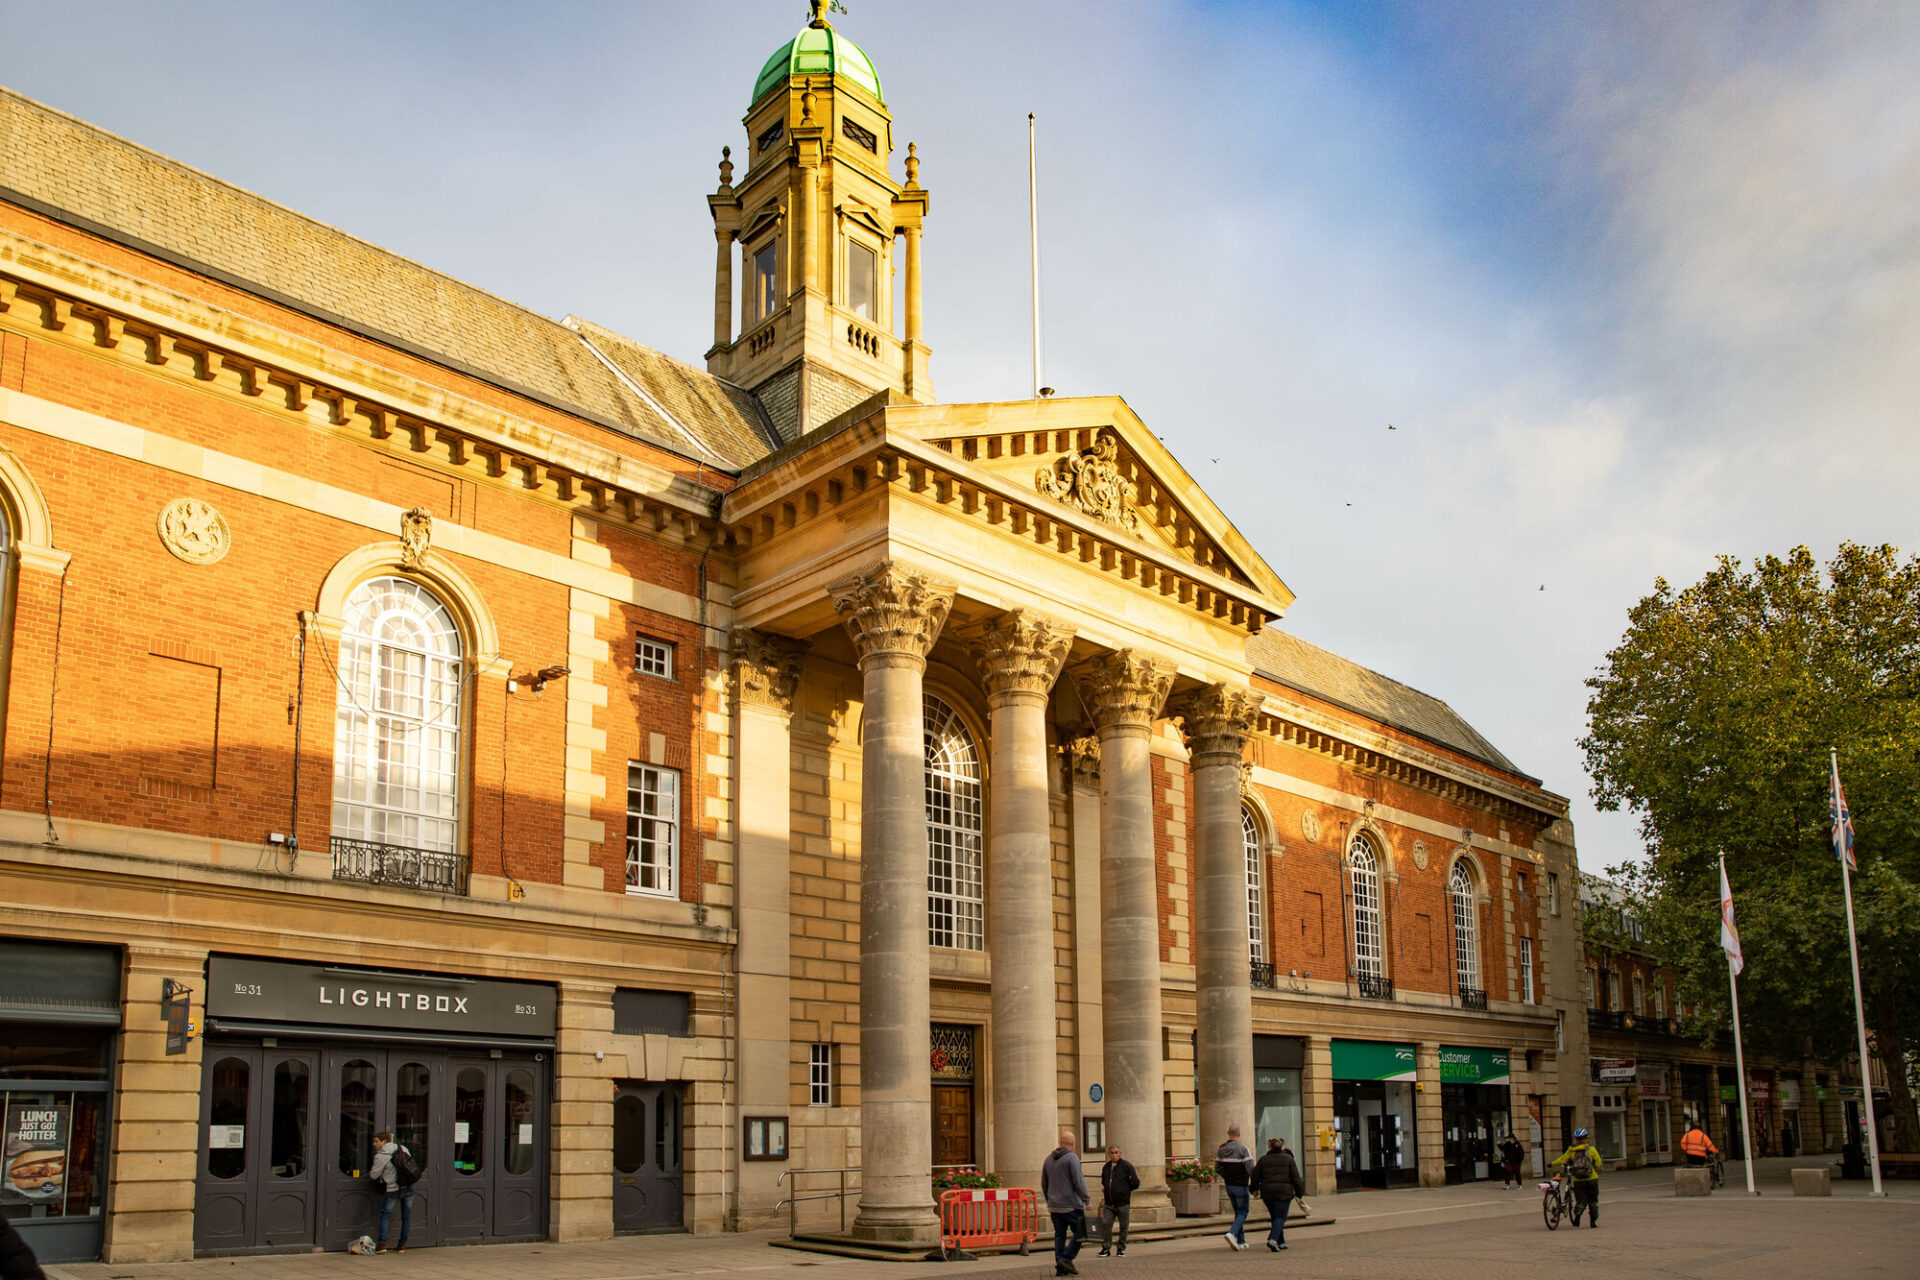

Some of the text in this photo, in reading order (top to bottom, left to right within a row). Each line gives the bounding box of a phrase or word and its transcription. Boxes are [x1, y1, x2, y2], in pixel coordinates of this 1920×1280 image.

[320, 986, 468, 1013] LIGHTBOX
[1437, 1050, 1471, 1064] Customer
[20, 1110, 58, 1122] LUNCH
[20, 1122, 57, 1131] JUST GOT
[19, 1130, 57, 1141] HOTTER
